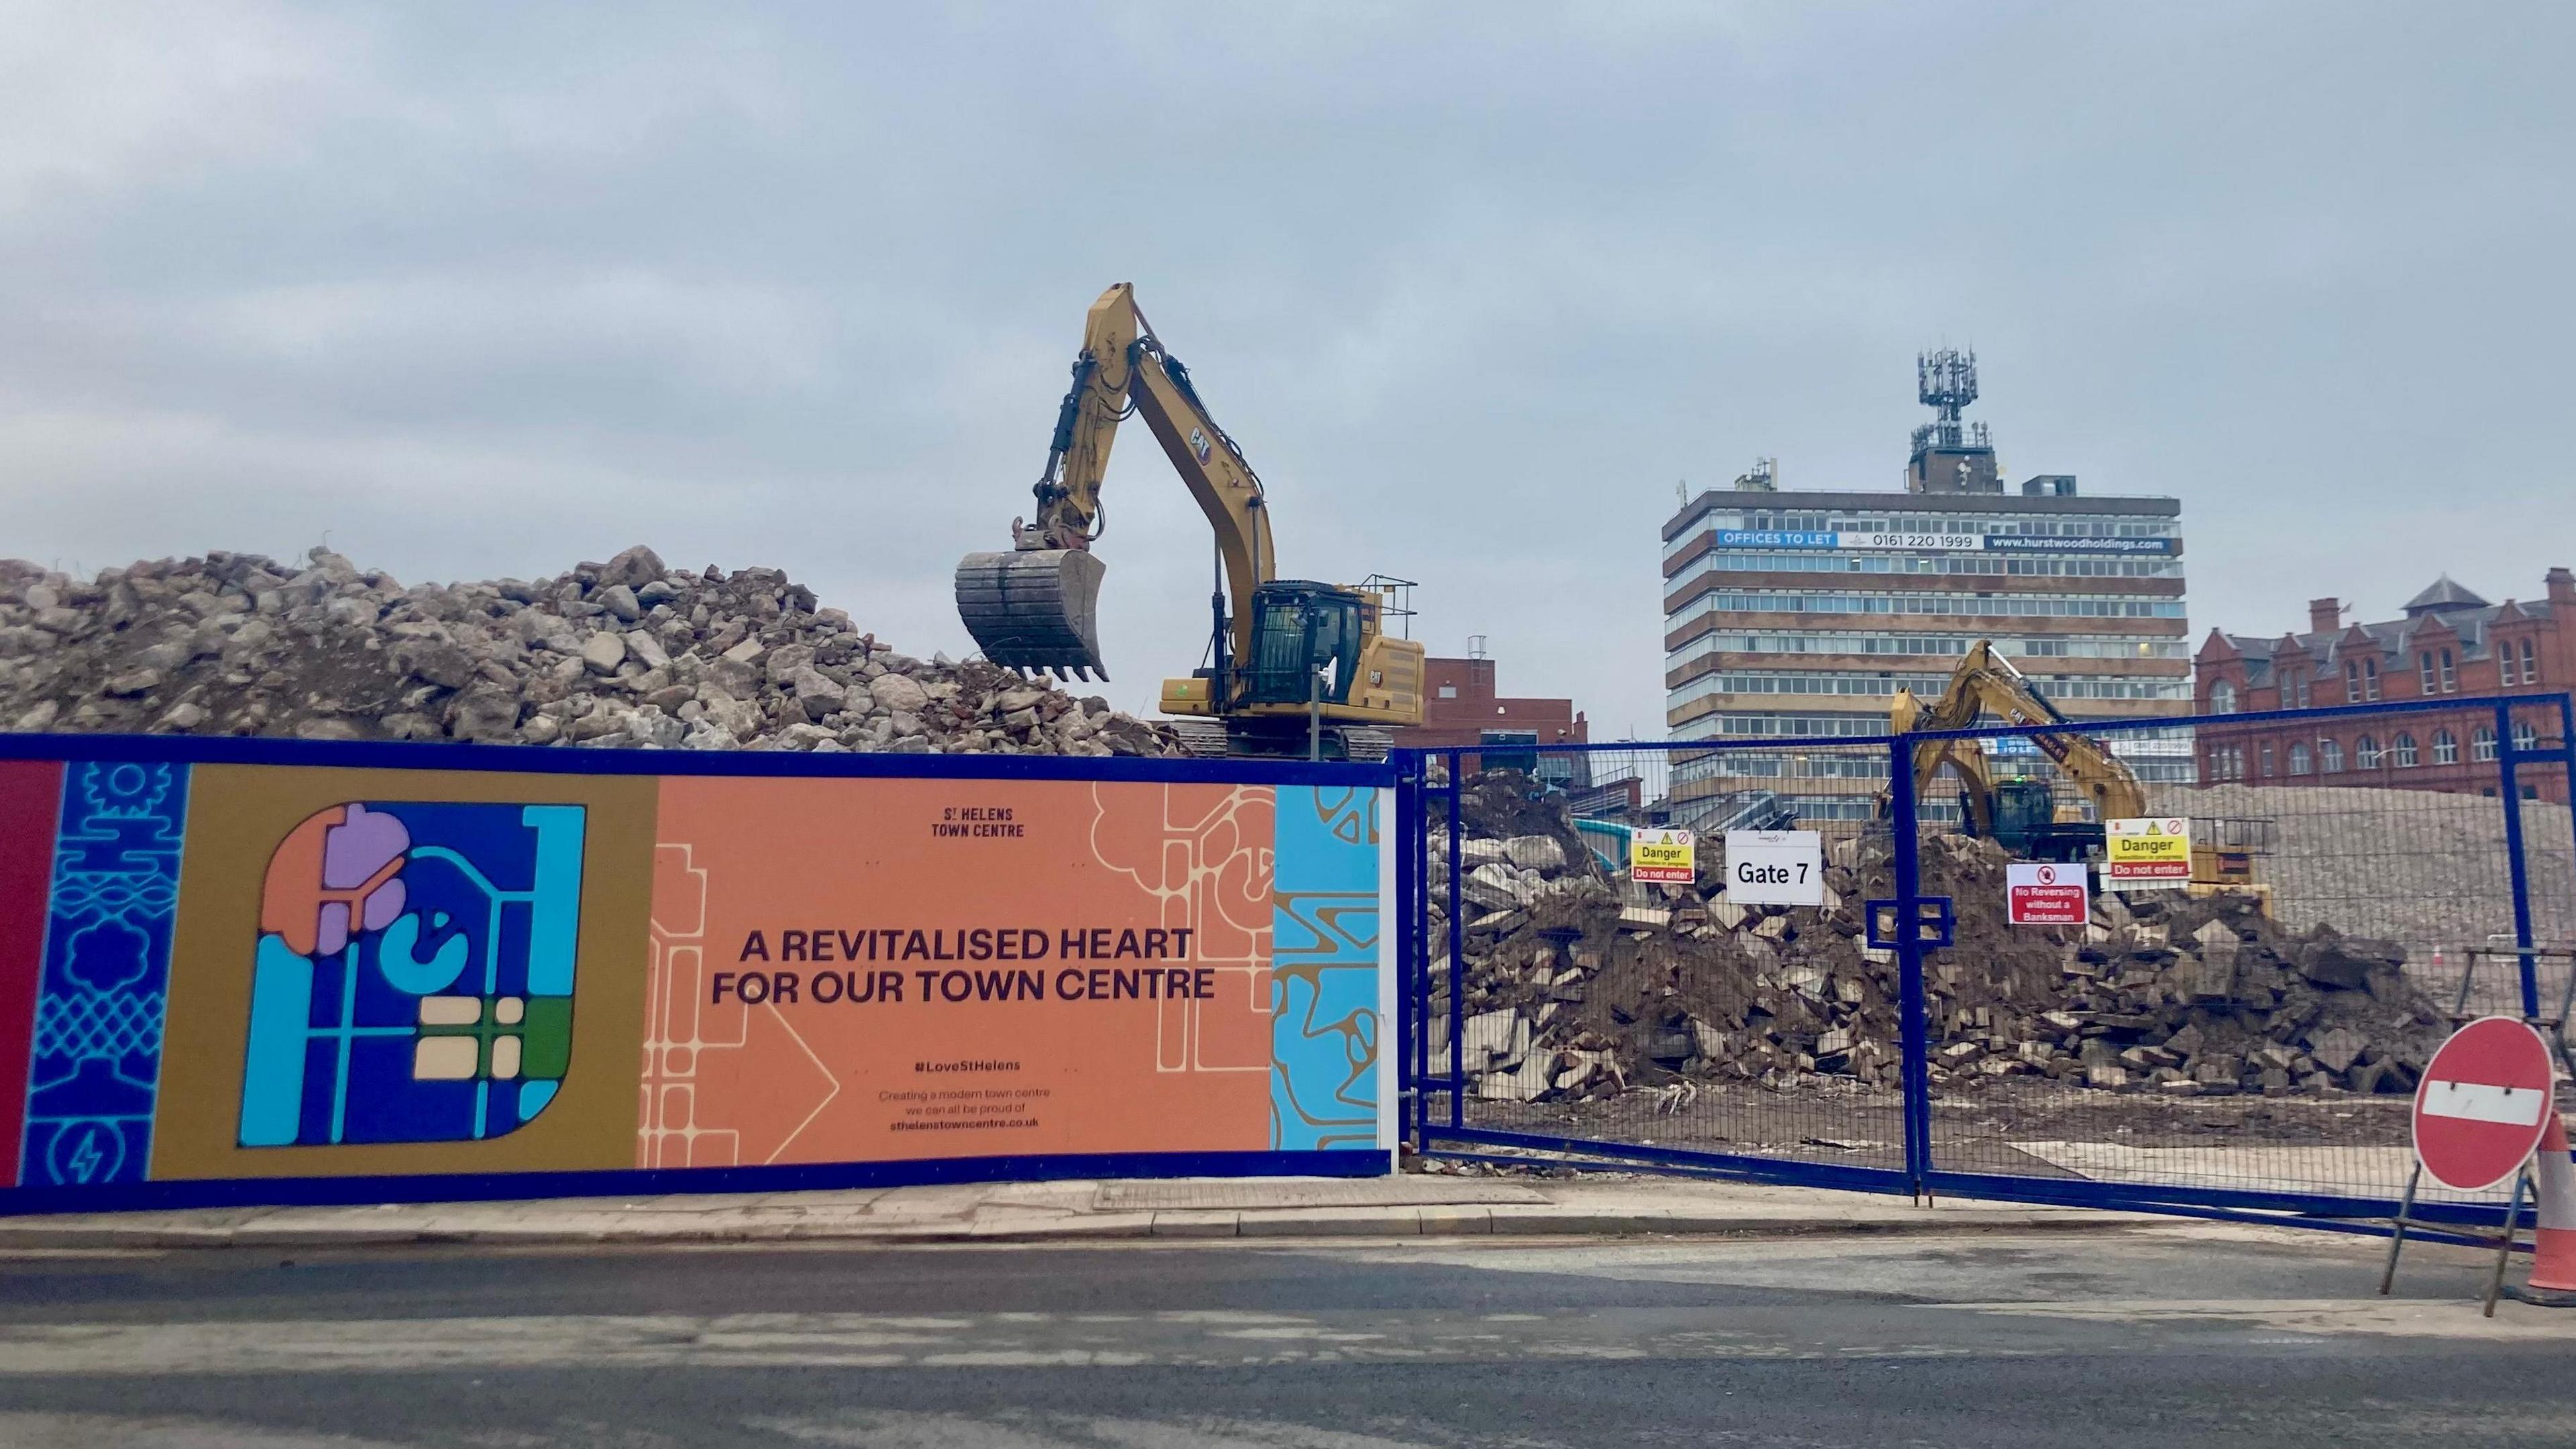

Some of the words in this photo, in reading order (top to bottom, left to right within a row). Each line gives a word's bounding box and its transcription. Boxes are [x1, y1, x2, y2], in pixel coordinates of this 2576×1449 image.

[1191, 427, 1210, 457] CAT
[1724, 533, 1780, 543] OFFICES
[1785, 534, 1803, 544] TO
[1808, 534, 1831, 545] LET
[1874, 535, 1902, 545] 0161
[1909, 536, 1935, 547] 220
[1941, 536, 1972, 547] 1999
[1993, 537, 2163, 549] www.hurstwoodholdings.com
[962, 808, 1013, 820] HELENS
[932, 824, 969, 837] TOWN
[973, 824, 1024, 837] CENTRE
[2121, 839, 2174, 854] Danger
[1642, 847, 1682, 861] Danger
[1636, 868, 1648, 878] Do
[1650, 870, 1664, 878] not
[1666, 871, 1689, 879] enter
[1738, 862, 1789, 883] Gate
[1796, 863, 1809, 884] 7
[2114, 865, 2131, 874] Do
[2133, 865, 2151, 874] not
[2154, 865, 2185, 874] enter
[2015, 887, 2029, 896] No
[2031, 887, 2080, 898] Reversing
[2026, 900, 2062, 909] without
[2023, 912, 2074, 921] Banksman
[739, 930, 770, 961] A
[782, 928, 1050, 961] REVITALISED
[1060, 928, 1193, 959] HEART
[712, 971, 800, 1004] FOR
[810, 970, 904, 1004] OUR
[914, 969, 1044, 1002] TOWN
[1055, 968, 1215, 1001] CENTRE
[915, 1060, 1020, 1073] #LoveStHelens
[879, 1089, 927, 1102] Creating
[939, 1089, 982, 1099] modern
[985, 1089, 1012, 1098] town
[1015, 1088, 1050, 1098] centre
[925, 1107, 945, 1115] can
[948, 1104, 960, 1114] all
[963, 1104, 977, 1114] be
[979, 1104, 1012, 1116] proud
[1014, 1103, 1026, 1113] of
[890, 1117, 1038, 1131] sthelenstowncentre.co.uk
